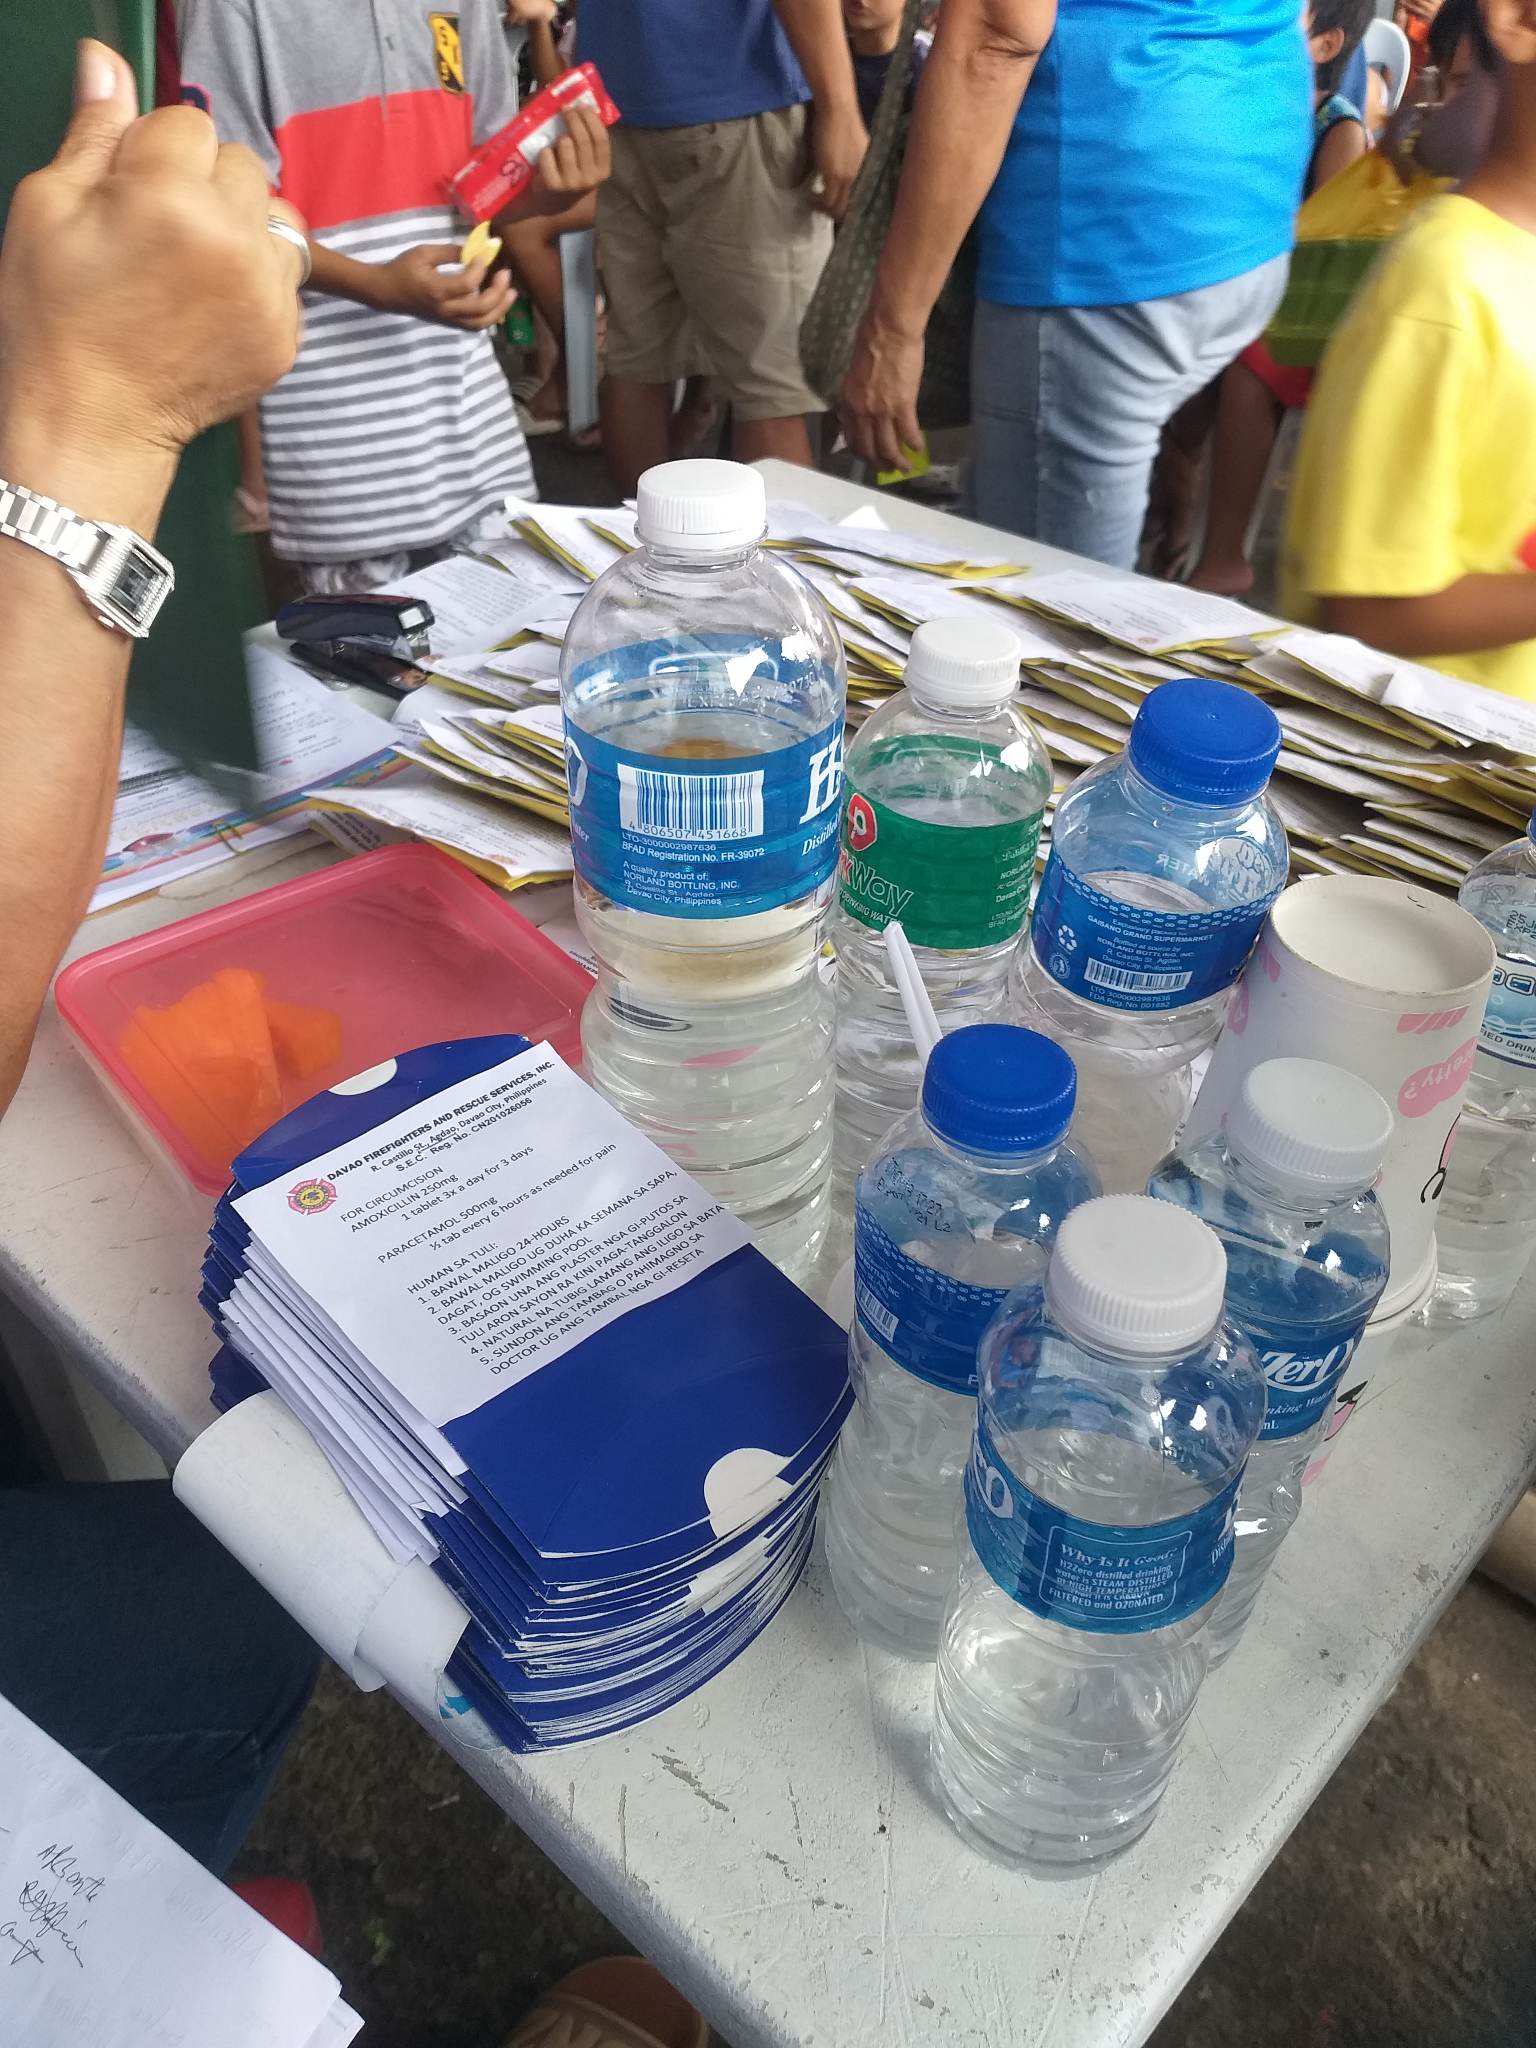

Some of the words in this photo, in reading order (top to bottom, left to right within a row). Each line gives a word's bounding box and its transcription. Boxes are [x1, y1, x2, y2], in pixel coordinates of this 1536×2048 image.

[622, 842, 646, 855] BFAD
[647, 848, 700, 861] Registration
[702, 853, 719, 862] No.
[721, 847, 765, 861] FR-39072
[643, 824, 691, 839] 806507
[698, 828, 748, 839] 451668
[623, 871, 666, 888] NORLAND
[668, 880, 719, 891] BOTTLING,
[721, 881, 740, 889] INC.
[627, 886, 652, 898] Davao
[674, 896, 722, 906] Philippines
[630, 864, 659, 877] quality
[660, 871, 695, 881] product
[1088, 915, 1121, 934] GAISANO
[1123, 929, 1152, 942] GRAND
[1154, 934, 1214, 943] SUPERMARKET
[1097, 936, 1134, 953] NORLAND
[1506, 1039, 1536, 1054] DRIN
[326, 1159, 363, 1184] DAVAO
[362, 1123, 433, 1163] FIREFIGHTERS
[432, 1112, 453, 1128] AND
[452, 1093, 491, 1117] RESCUE
[489, 1071, 537, 1098] SERVICES,
[534, 1061, 555, 1074] INC.
[368, 1161, 382, 1172] R.
[381, 1143, 414, 1167] Castillo
[411, 1139, 432, 1154] St.,
[429, 1123, 460, 1146] Agdao,
[457, 1108, 487, 1129] Davao
[484, 1098, 506, 1116] City,
[502, 1077, 547, 1107] Philippines
[394, 1149, 428, 1172] S.E.C.
[428, 1135, 454, 1155] Reg.
[451, 1126, 472, 1143] No.
[469, 1094, 533, 1133] CN201026056
[339, 1206, 366, 1223] FOR
[364, 1165, 444, 1211] CIRCUMCISION
[351, 1189, 421, 1233] AMOXICILLIN
[418, 1174, 461, 1199] 250mg
[400, 1209, 411, 1222] 1
[409, 1192, 444, 1216] tablet
[441, 1183, 458, 1199] 3x
[455, 1180, 466, 1192] a
[463, 1171, 485, 1187] day
[484, 1163, 500, 1177] for
[499, 1158, 510, 1167] 3
[509, 1146, 534, 1162] days
[441, 1227, 462, 1245] tab
[459, 1209, 491, 1234] every
[489, 1205, 500, 1218] 6
[497, 1192, 530, 1213] hours
[529, 1185, 544, 1195] as
[541, 1162, 580, 1188] needed
[577, 1155, 597, 1167] for
[594, 1144, 617, 1160] pain
[377, 1215, 461, 1264] PARACETAMOL
[458, 1196, 499, 1221] 500mg
[426, 1300, 444, 1316] 2.
[439, 1277, 485, 1311] BAWAL
[480, 1252, 529, 1288] MALIGO
[525, 1242, 548, 1262] UG
[543, 1226, 579, 1252] DUHA
[575, 1217, 593, 1234] KA
[590, 1192, 636, 1223] SEMANA
[633, 1183, 650, 1199] SA
[646, 1169, 678, 1190] SAPA,
[407, 1263, 455, 1294] HUMAN
[452, 1254, 471, 1271] SA
[467, 1242, 499, 1262] TULI:
[417, 1294, 432, 1305] 1.
[429, 1270, 474, 1298] BAWAL
[471, 1244, 518, 1277] MALIGO
[515, 1215, 570, 1251] 24-HOURS
[435, 1294, 483, 1327] DAGAT,
[479, 1282, 503, 1304] OG
[499, 1247, 565, 1292] SWIMMING
[560, 1233, 593, 1258] POOL
[446, 1321, 464, 1335] 3.
[460, 1294, 510, 1330] BASAON
[507, 1282, 537, 1305] UNA
[532, 1265, 561, 1289] ANG
[558, 1242, 607, 1274] PLASTER
[602, 1231, 629, 1250] NGA
[626, 1201, 675, 1236] GI-PUTOS
[672, 1194, 689, 1209] SA
[456, 1323, 487, 1345] TULI
[483, 1305, 522, 1333] ARON
[516, 1283, 559, 1315] SAYON
[555, 1273, 575, 1293] RA
[571, 1260, 599, 1282] KINI
[594, 1206, 690, 1268] PAGA-TANGGALON
[470, 1340, 485, 1356] 4.
[480, 1311, 537, 1351] NATURAL
[533, 1300, 557, 1320] NA
[551, 1283, 590, 1311] TUBIG
[585, 1254, 637, 1292] LAMANG
[631, 1239, 660, 1264] ANG
[654, 1224, 687, 1250] ILIGO
[682, 1216, 700, 1234] SA
[696, 1201, 725, 1223] BATA
[478, 1350, 495, 1367] 5.
[491, 1324, 544, 1360] SUNDON
[543, 1307, 571, 1332] ANG
[567, 1280, 619, 1315] TAMBAG
[612, 1274, 629, 1291] O
[624, 1236, 692, 1284] PAHIMAGNO
[686, 1228, 705, 1246] SA
[489, 1339, 541, 1375] DOCTOR
[538, 1330, 559, 1346] UG
[559, 1313, 585, 1335] ANG
[582, 1287, 630, 1318] TAMBAL
[626, 1275, 654, 1295] NGA
[651, 1245, 704, 1281] GI-RESETA
[1055, 1567, 1080, 1582] water
[1091, 1578, 1124, 1587] STEAM
[1128, 1571, 1174, 1587] DISTILLED
[1060, 1559, 1092, 1577] H2Zero
[1095, 1569, 1132, 1580] distilled
[1135, 1564, 1172, 1579] drinking
[1061, 1543, 1095, 1566] Why
[1099, 1556, 1112, 1567] Is
[1118, 1557, 1130, 1567] It
[1049, 1587, 1092, 1607] FILTERED
[1094, 1600, 1112, 1609] and
[1115, 1593, 1165, 1609] OZONATED.
[1069, 1580, 1092, 1593] HIGH
